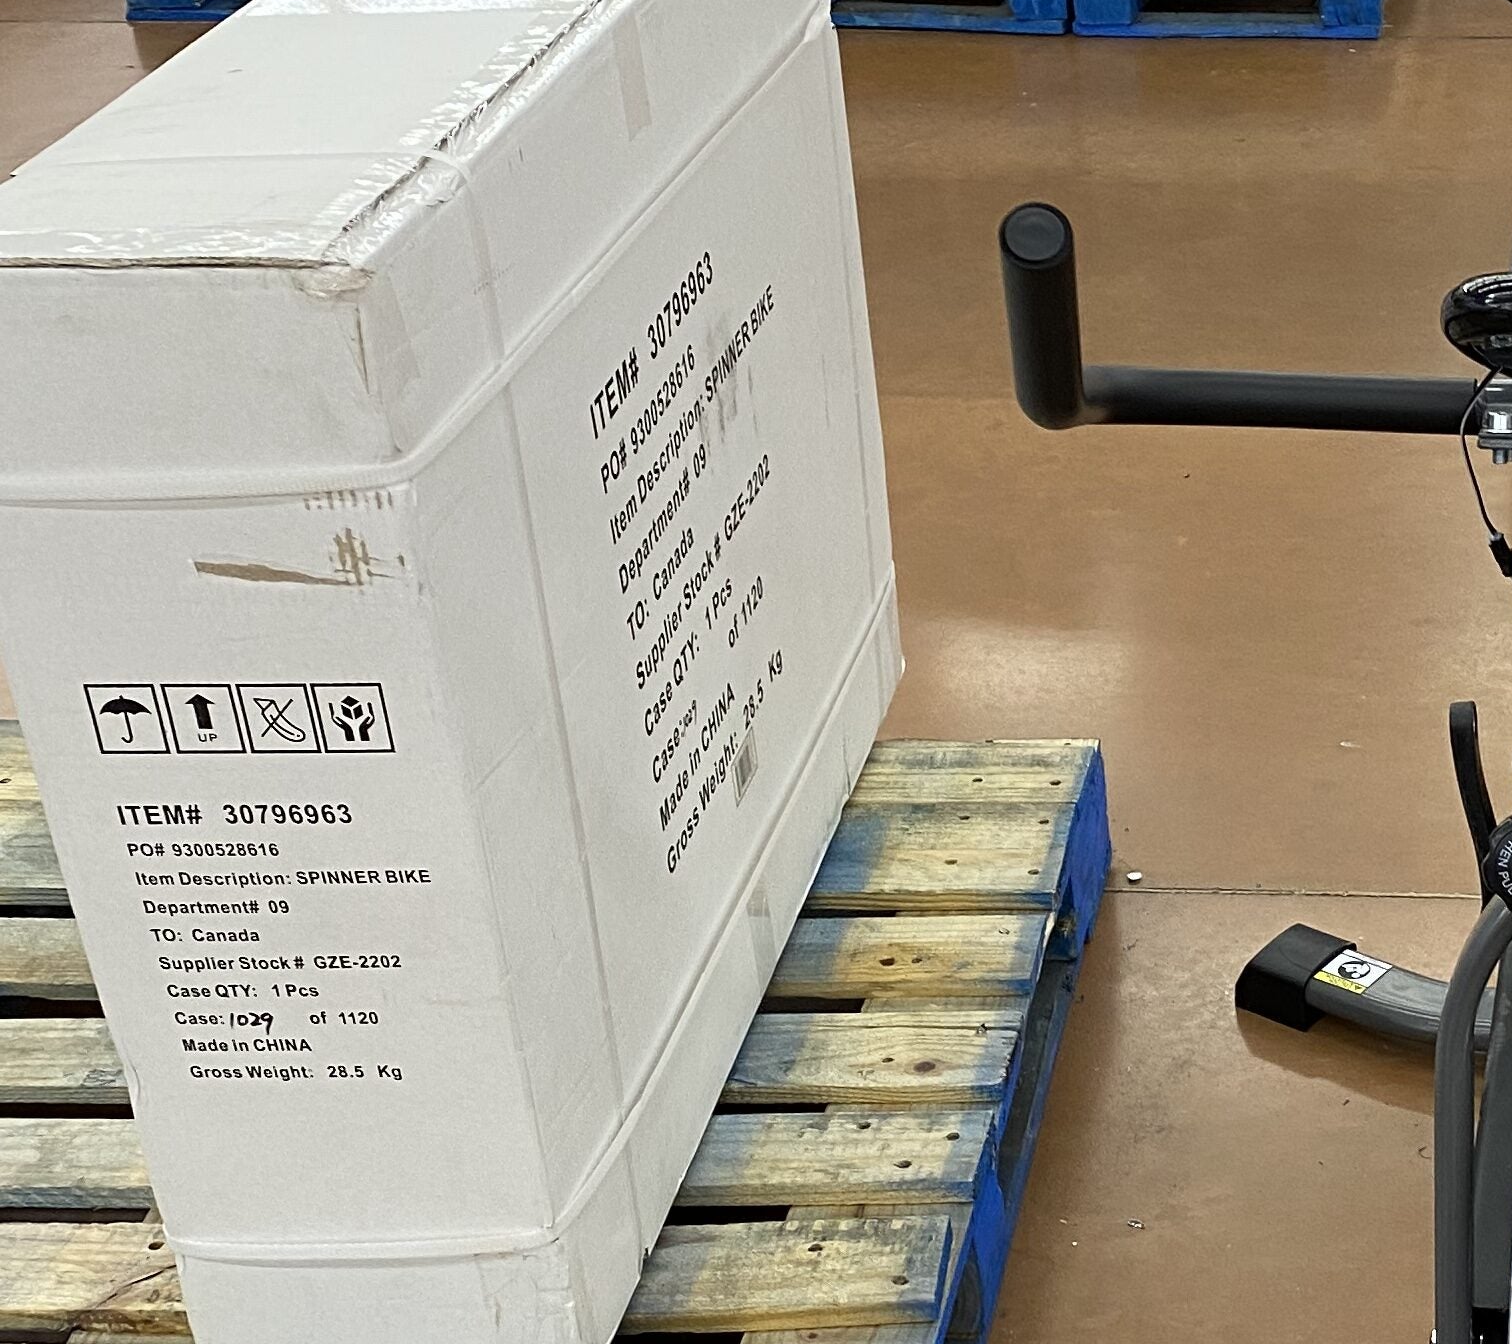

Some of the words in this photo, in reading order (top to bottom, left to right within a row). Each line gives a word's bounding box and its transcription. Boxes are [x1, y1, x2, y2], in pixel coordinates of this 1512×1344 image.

[589, 346, 640, 441] ITEM#
[646, 247, 713, 363] 30796963
[600, 437, 628, 496] PO#
[628, 341, 695, 457] 9300528616
[609, 486, 637, 547] Item
[636, 386, 705, 511] Description:
[704, 317, 752, 403] SPINNER
[749, 285, 775, 333] BIKE
[618, 465, 692, 601] Department#
[692, 441, 707, 480] 09
[626, 590, 650, 645] TO:
[651, 519, 694, 604] Canada
[635, 596, 684, 697] Supplier
[682, 545, 714, 613] Stock
[723, 452, 770, 544] GZE-2202
[643, 673, 673, 740] Case
[672, 627, 700, 691] QTY:
[711, 570, 732, 621] Pcs
[651, 713, 684, 787] Case:
[727, 614, 739, 651] of
[740, 572, 764, 629] 1120
[198, 733, 218, 743] UP
[658, 761, 689, 833] Made
[688, 740, 700, 777] in
[700, 677, 735, 755] CHINA
[665, 798, 700, 877] Gross
[698, 725, 739, 818] Weight:
[742, 676, 764, 732] 28.5
[767, 643, 783, 688] Kg
[116, 804, 202, 825] ITEM#
[223, 803, 352, 824] 30796963
[127, 842, 164, 857] PO#
[172, 842, 279, 857] 9300528616
[135, 872, 175, 886] Item
[179, 871, 291, 888] Description:
[296, 870, 381, 885] SPINNER
[386, 869, 431, 884] BIKE
[143, 900, 260, 916] Department#
[268, 900, 289, 914] 09
[150, 928, 184, 943] TO:
[192, 928, 260, 943] Canada
[158, 956, 234, 972] Supplier
[239, 956, 290, 970] Stock
[313, 955, 402, 970] GZE-2202
[167, 985, 211, 998] Case
[214, 984, 257, 999] QTY:
[271, 984, 279, 997] 1
[286, 984, 319, 998] Pcs
[174, 1012, 224, 1026] Case:
[229, 1012, 274, 1034] 1029
[309, 1011, 327, 1025] of
[338, 1012, 379, 1025] 1120
[182, 1038, 228, 1052] Made
[232, 1038, 248, 1052] in
[253, 1038, 312, 1052] CHINA
[189, 1065, 243, 1079] Gross
[245, 1065, 314, 1081] Weight:
[327, 1065, 364, 1078] 28.5
[377, 1065, 403, 1081] Kg
